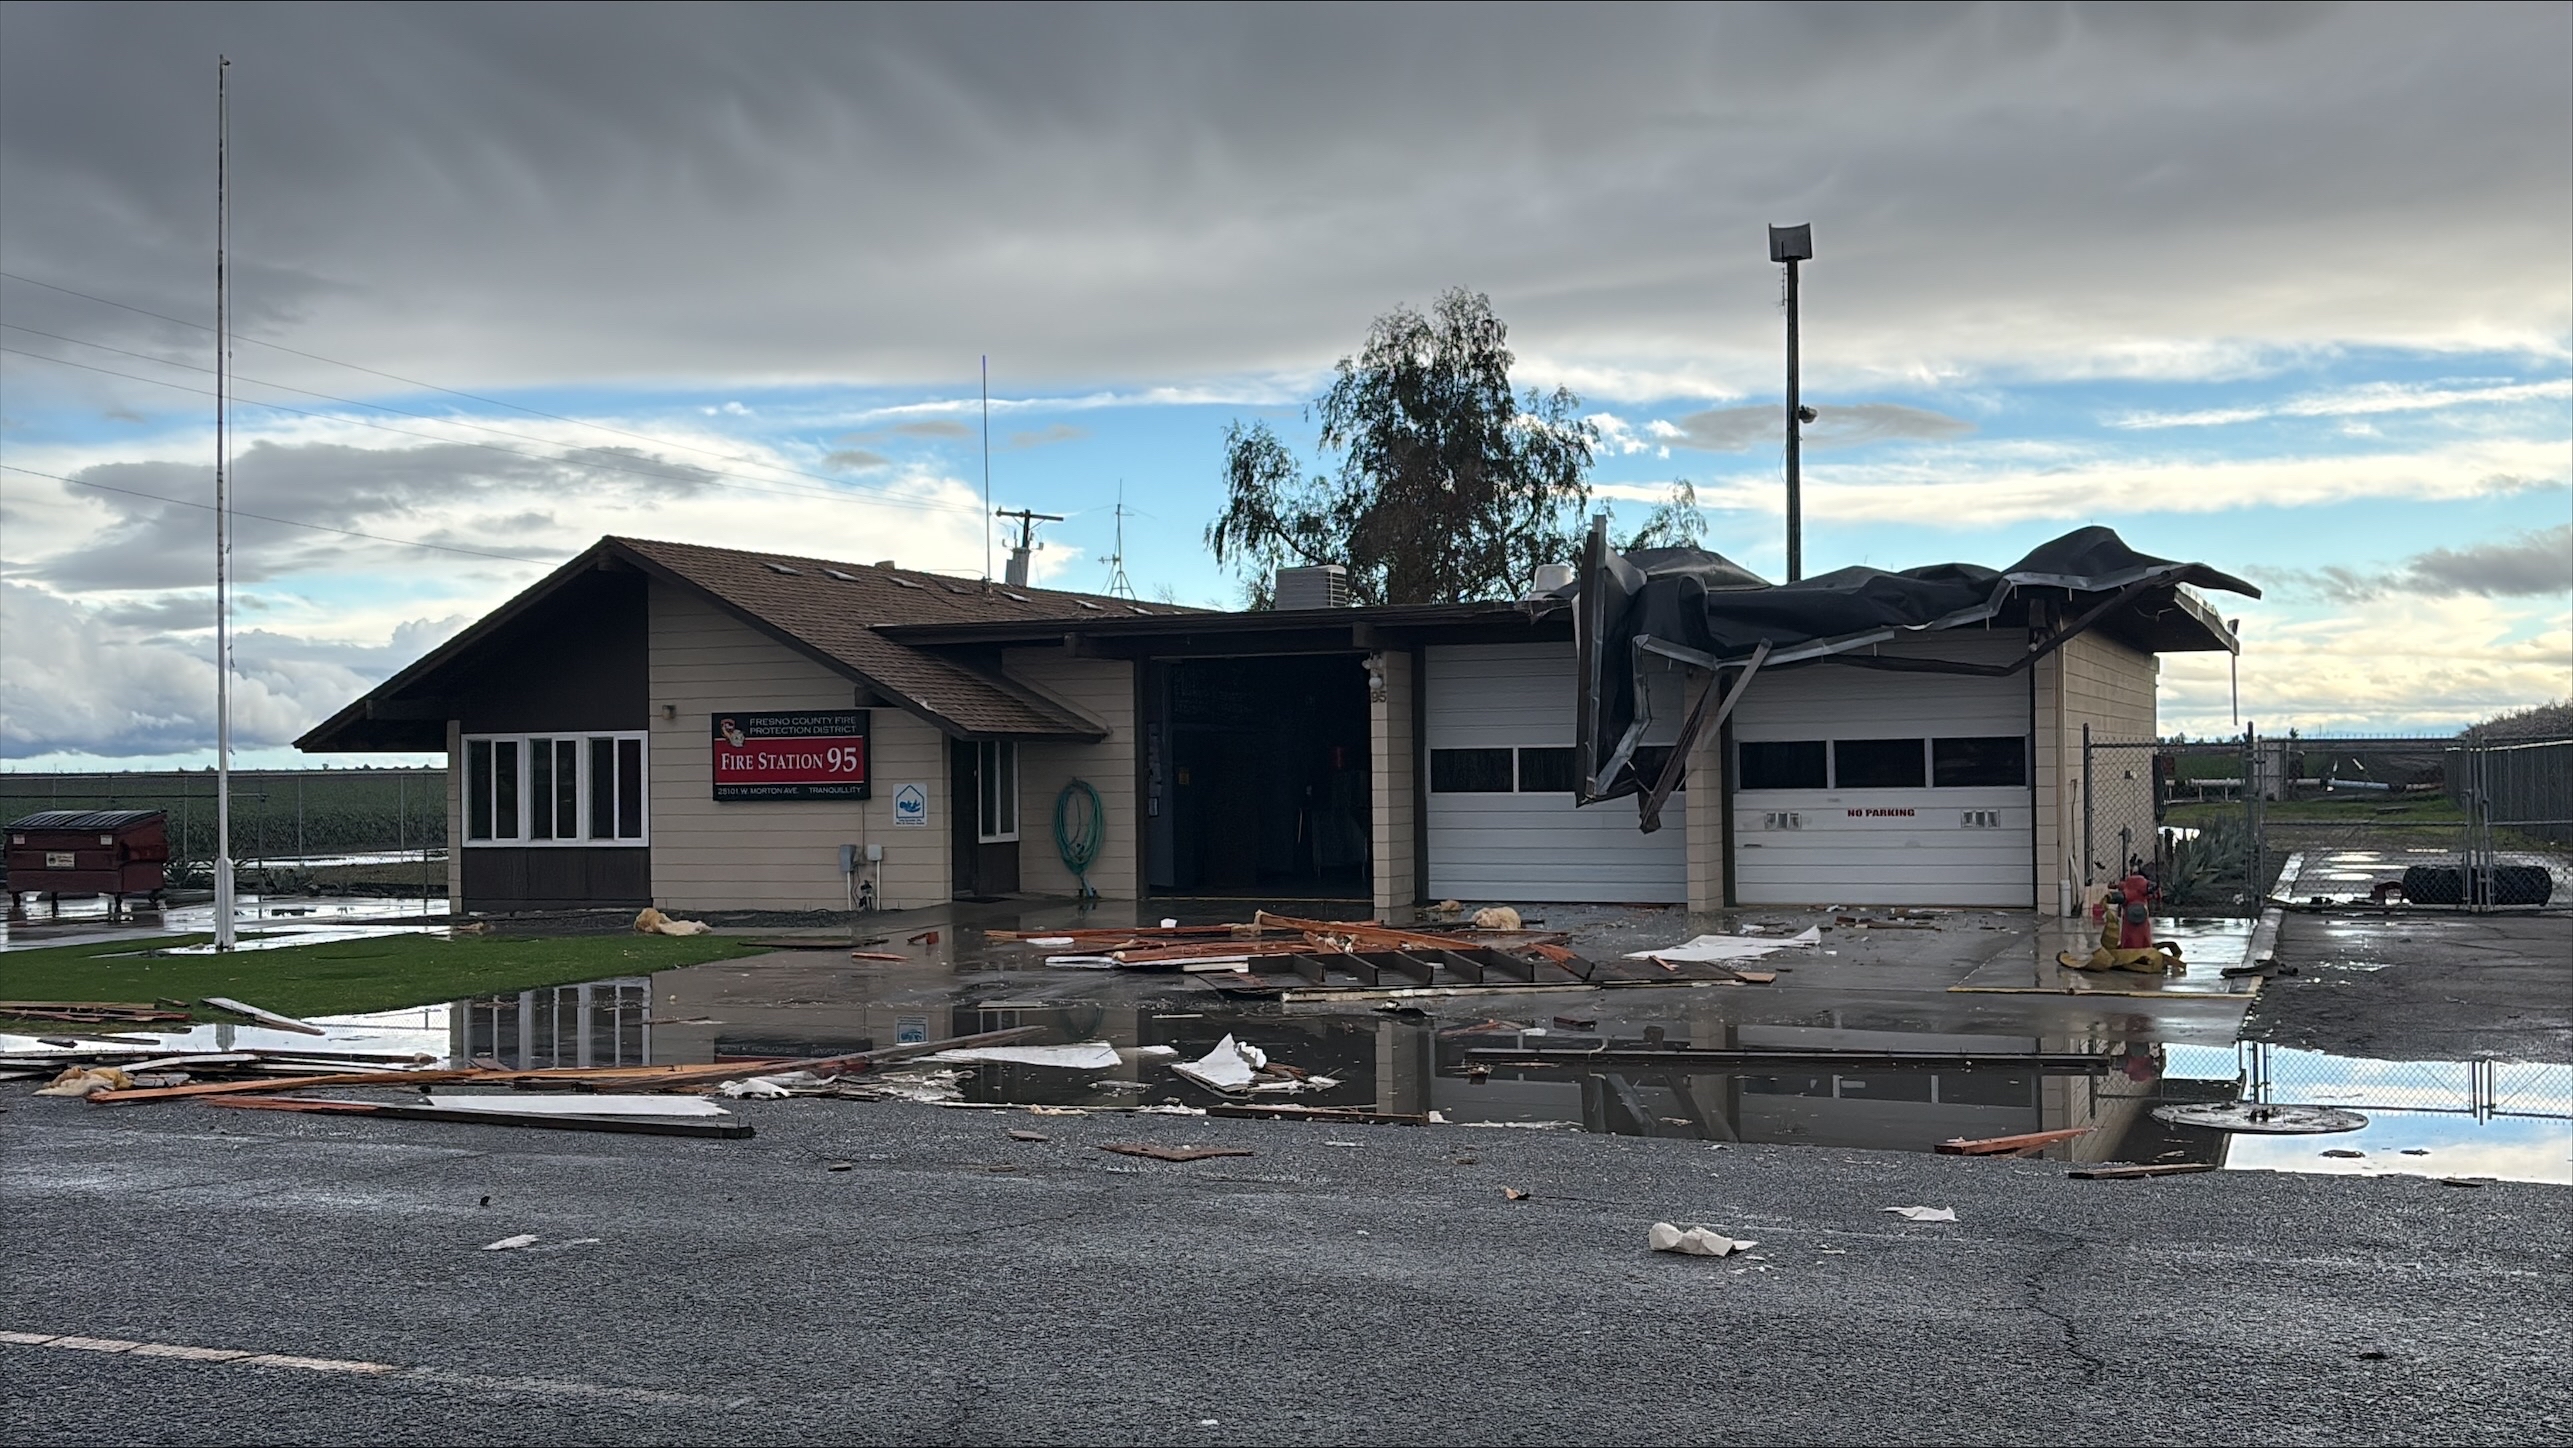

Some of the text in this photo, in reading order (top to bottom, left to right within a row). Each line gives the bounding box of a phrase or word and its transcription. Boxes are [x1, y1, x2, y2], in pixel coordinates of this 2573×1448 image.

[1372, 691, 1387, 703] 95
[749, 716, 857, 726] FRESNO COUNTY FIRE
[749, 725, 857, 735] PROTECTION DISTRICT
[721, 747, 857, 773] FIRE STATION 95
[750, 787, 783, 795] MORTON
[808, 786, 862, 794] TRANQUILLITY
[1847, 808, 1915, 817] NO PARKING
